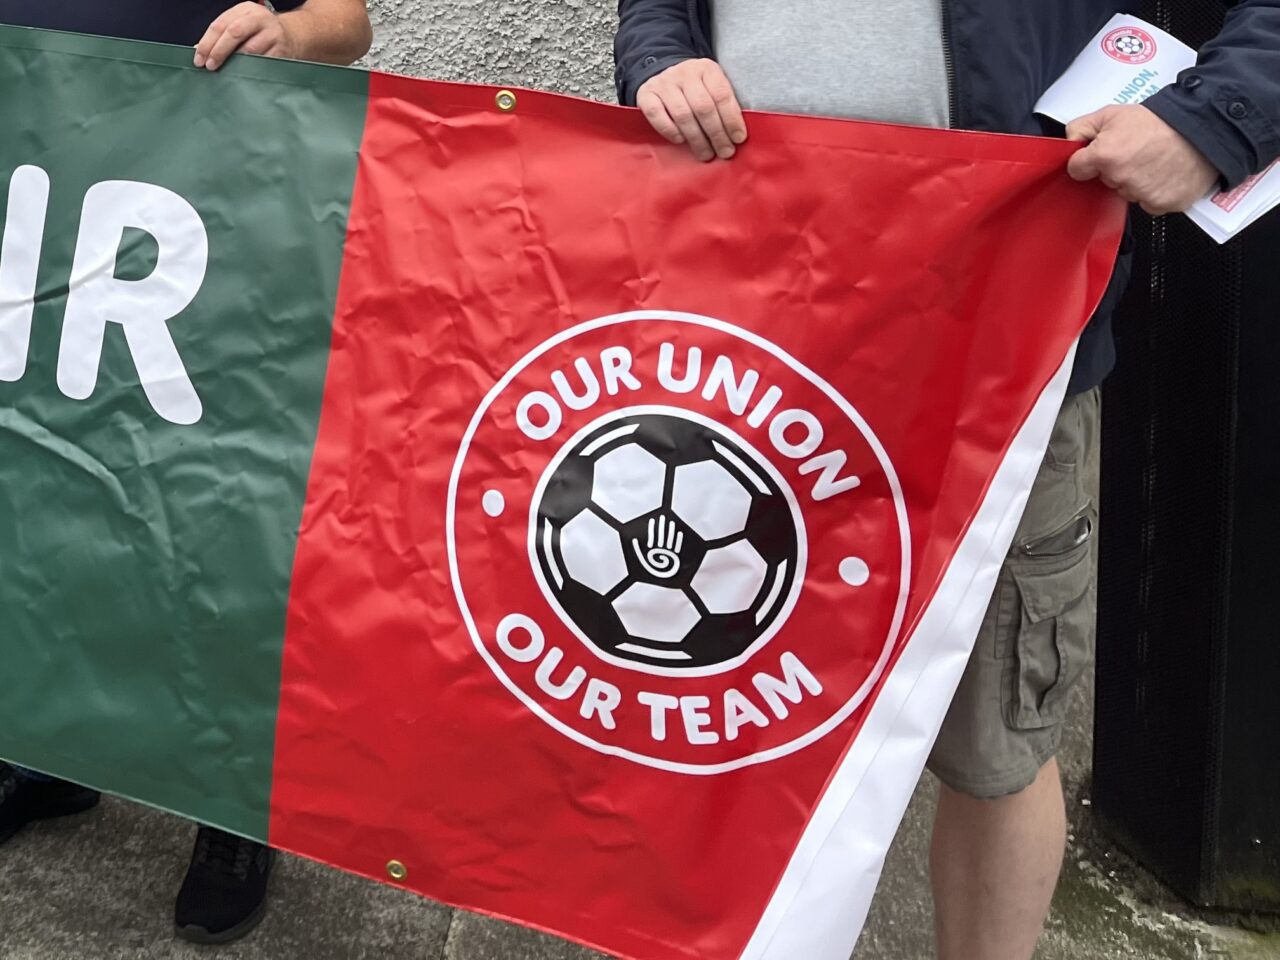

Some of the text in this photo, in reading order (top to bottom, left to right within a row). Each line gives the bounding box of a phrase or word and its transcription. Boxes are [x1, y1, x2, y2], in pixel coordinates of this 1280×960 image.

[516, 342, 861, 501] OUR UNION
[496, 613, 823, 745] OUR TEAM
